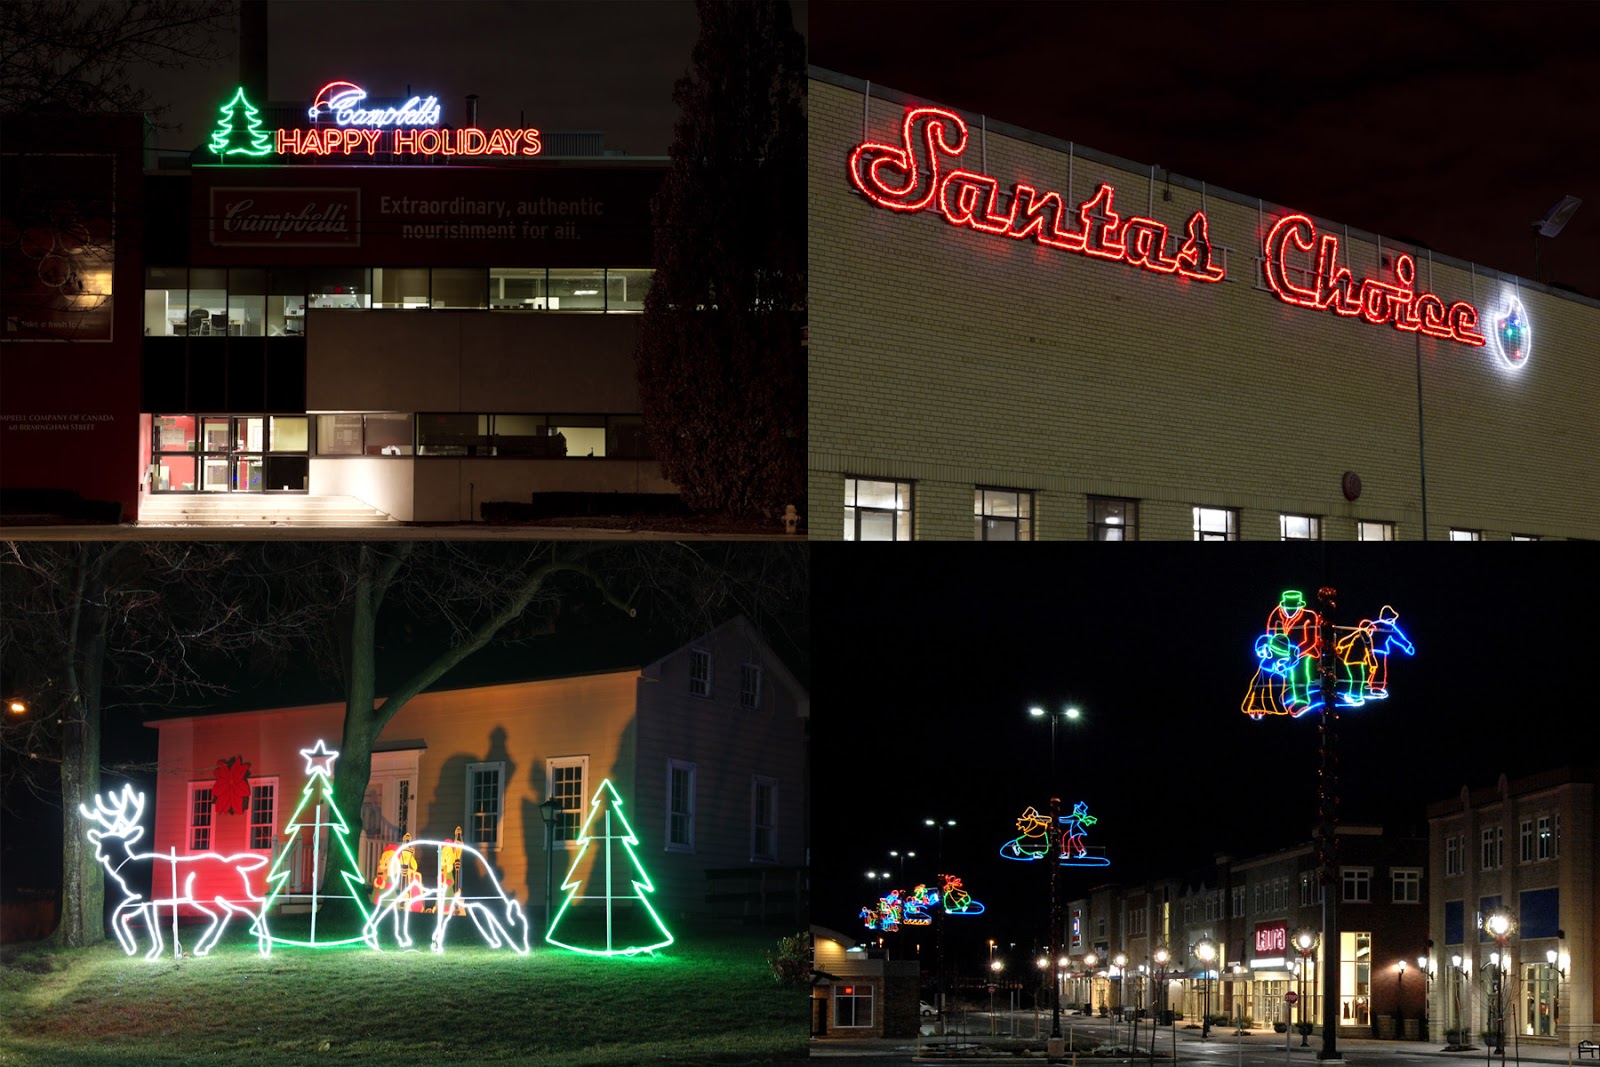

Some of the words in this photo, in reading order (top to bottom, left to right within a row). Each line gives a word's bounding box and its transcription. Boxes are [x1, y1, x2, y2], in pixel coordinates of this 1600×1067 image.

[276, 128, 382, 156] HAPPY
[393, 128, 542, 156] HOLIDAYS
[379, 195, 512, 218] Extraordinary,
[515, 195, 606, 216] authentic
[223, 198, 349, 240] Campbell's
[401, 221, 515, 240] nourishment
[521, 221, 551, 240] for
[848, 106, 1226, 284] Santas
[1263, 212, 1487, 348] Choice
[19, 423, 69, 431] BIRMINGHAM
[70, 423, 95, 431] STREET
[28, 414, 68, 422] COMPANY
[69, 414, 80, 422] OF
[81, 413, 115, 422] CANADA
